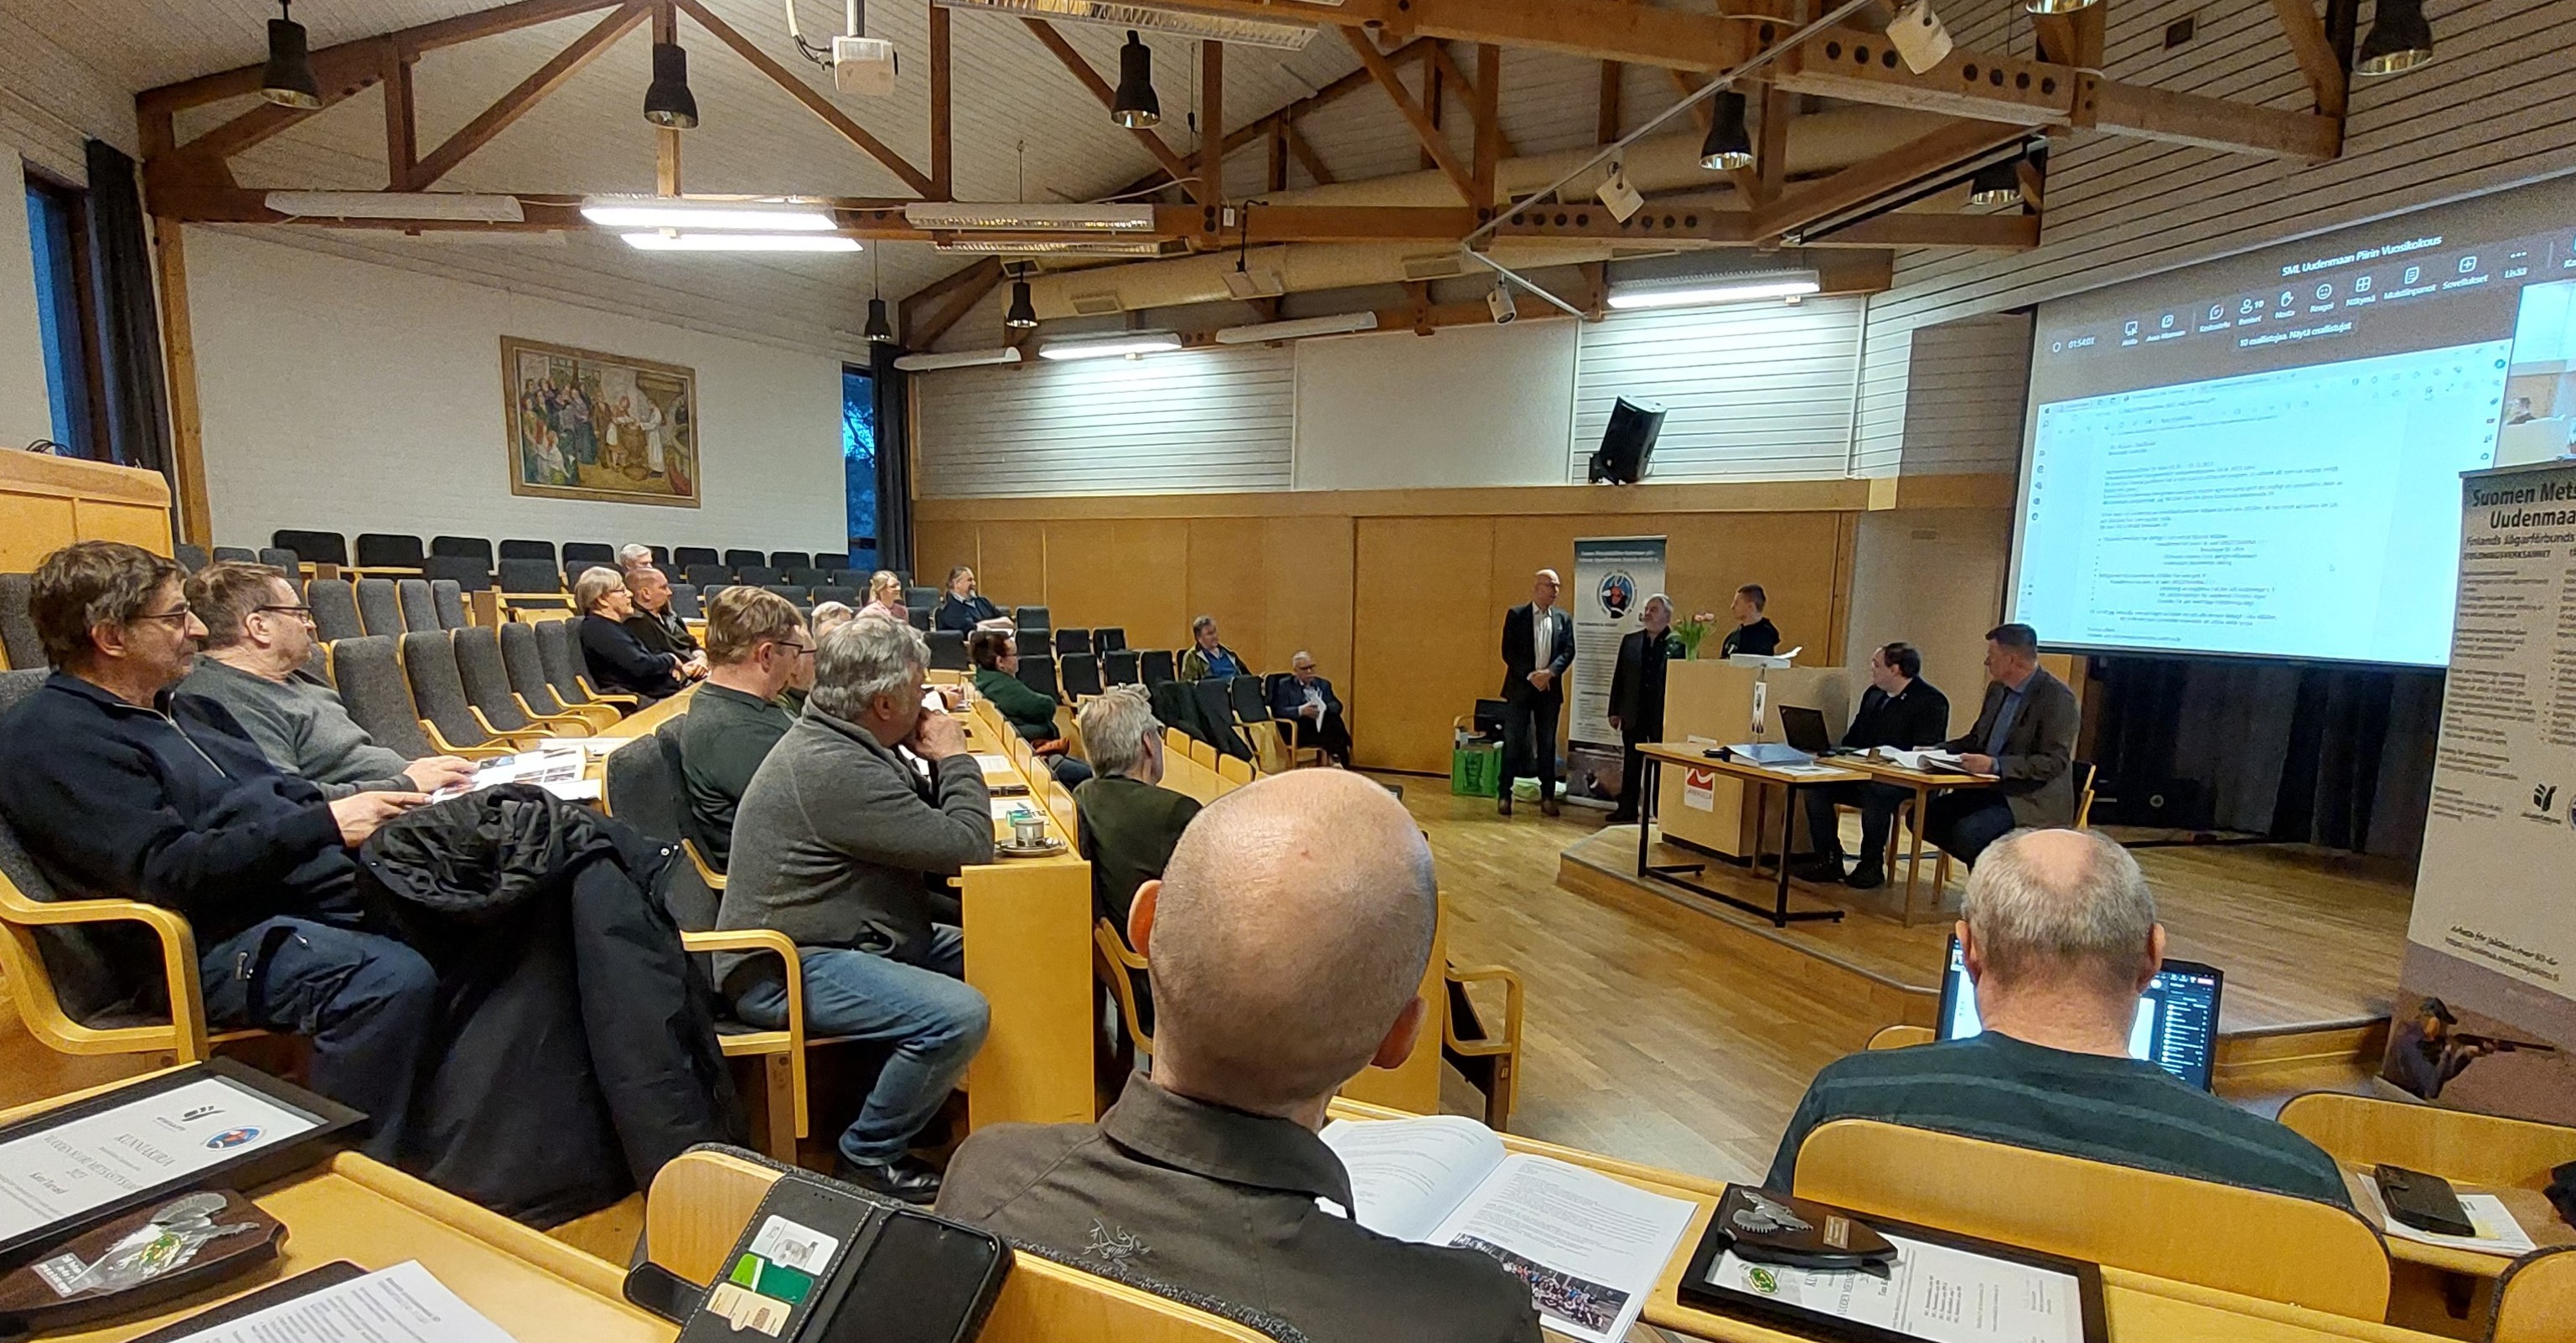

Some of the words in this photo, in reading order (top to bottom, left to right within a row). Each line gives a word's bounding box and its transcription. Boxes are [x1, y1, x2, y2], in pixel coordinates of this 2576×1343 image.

[2281, 264, 2301, 276] SML
[2302, 256, 2355, 273] Uudenmaan
[2356, 249, 2380, 262] Piirin
[2381, 236, 2443, 256] Vuosikokous
[2472, 487, 2535, 507] Suomen
